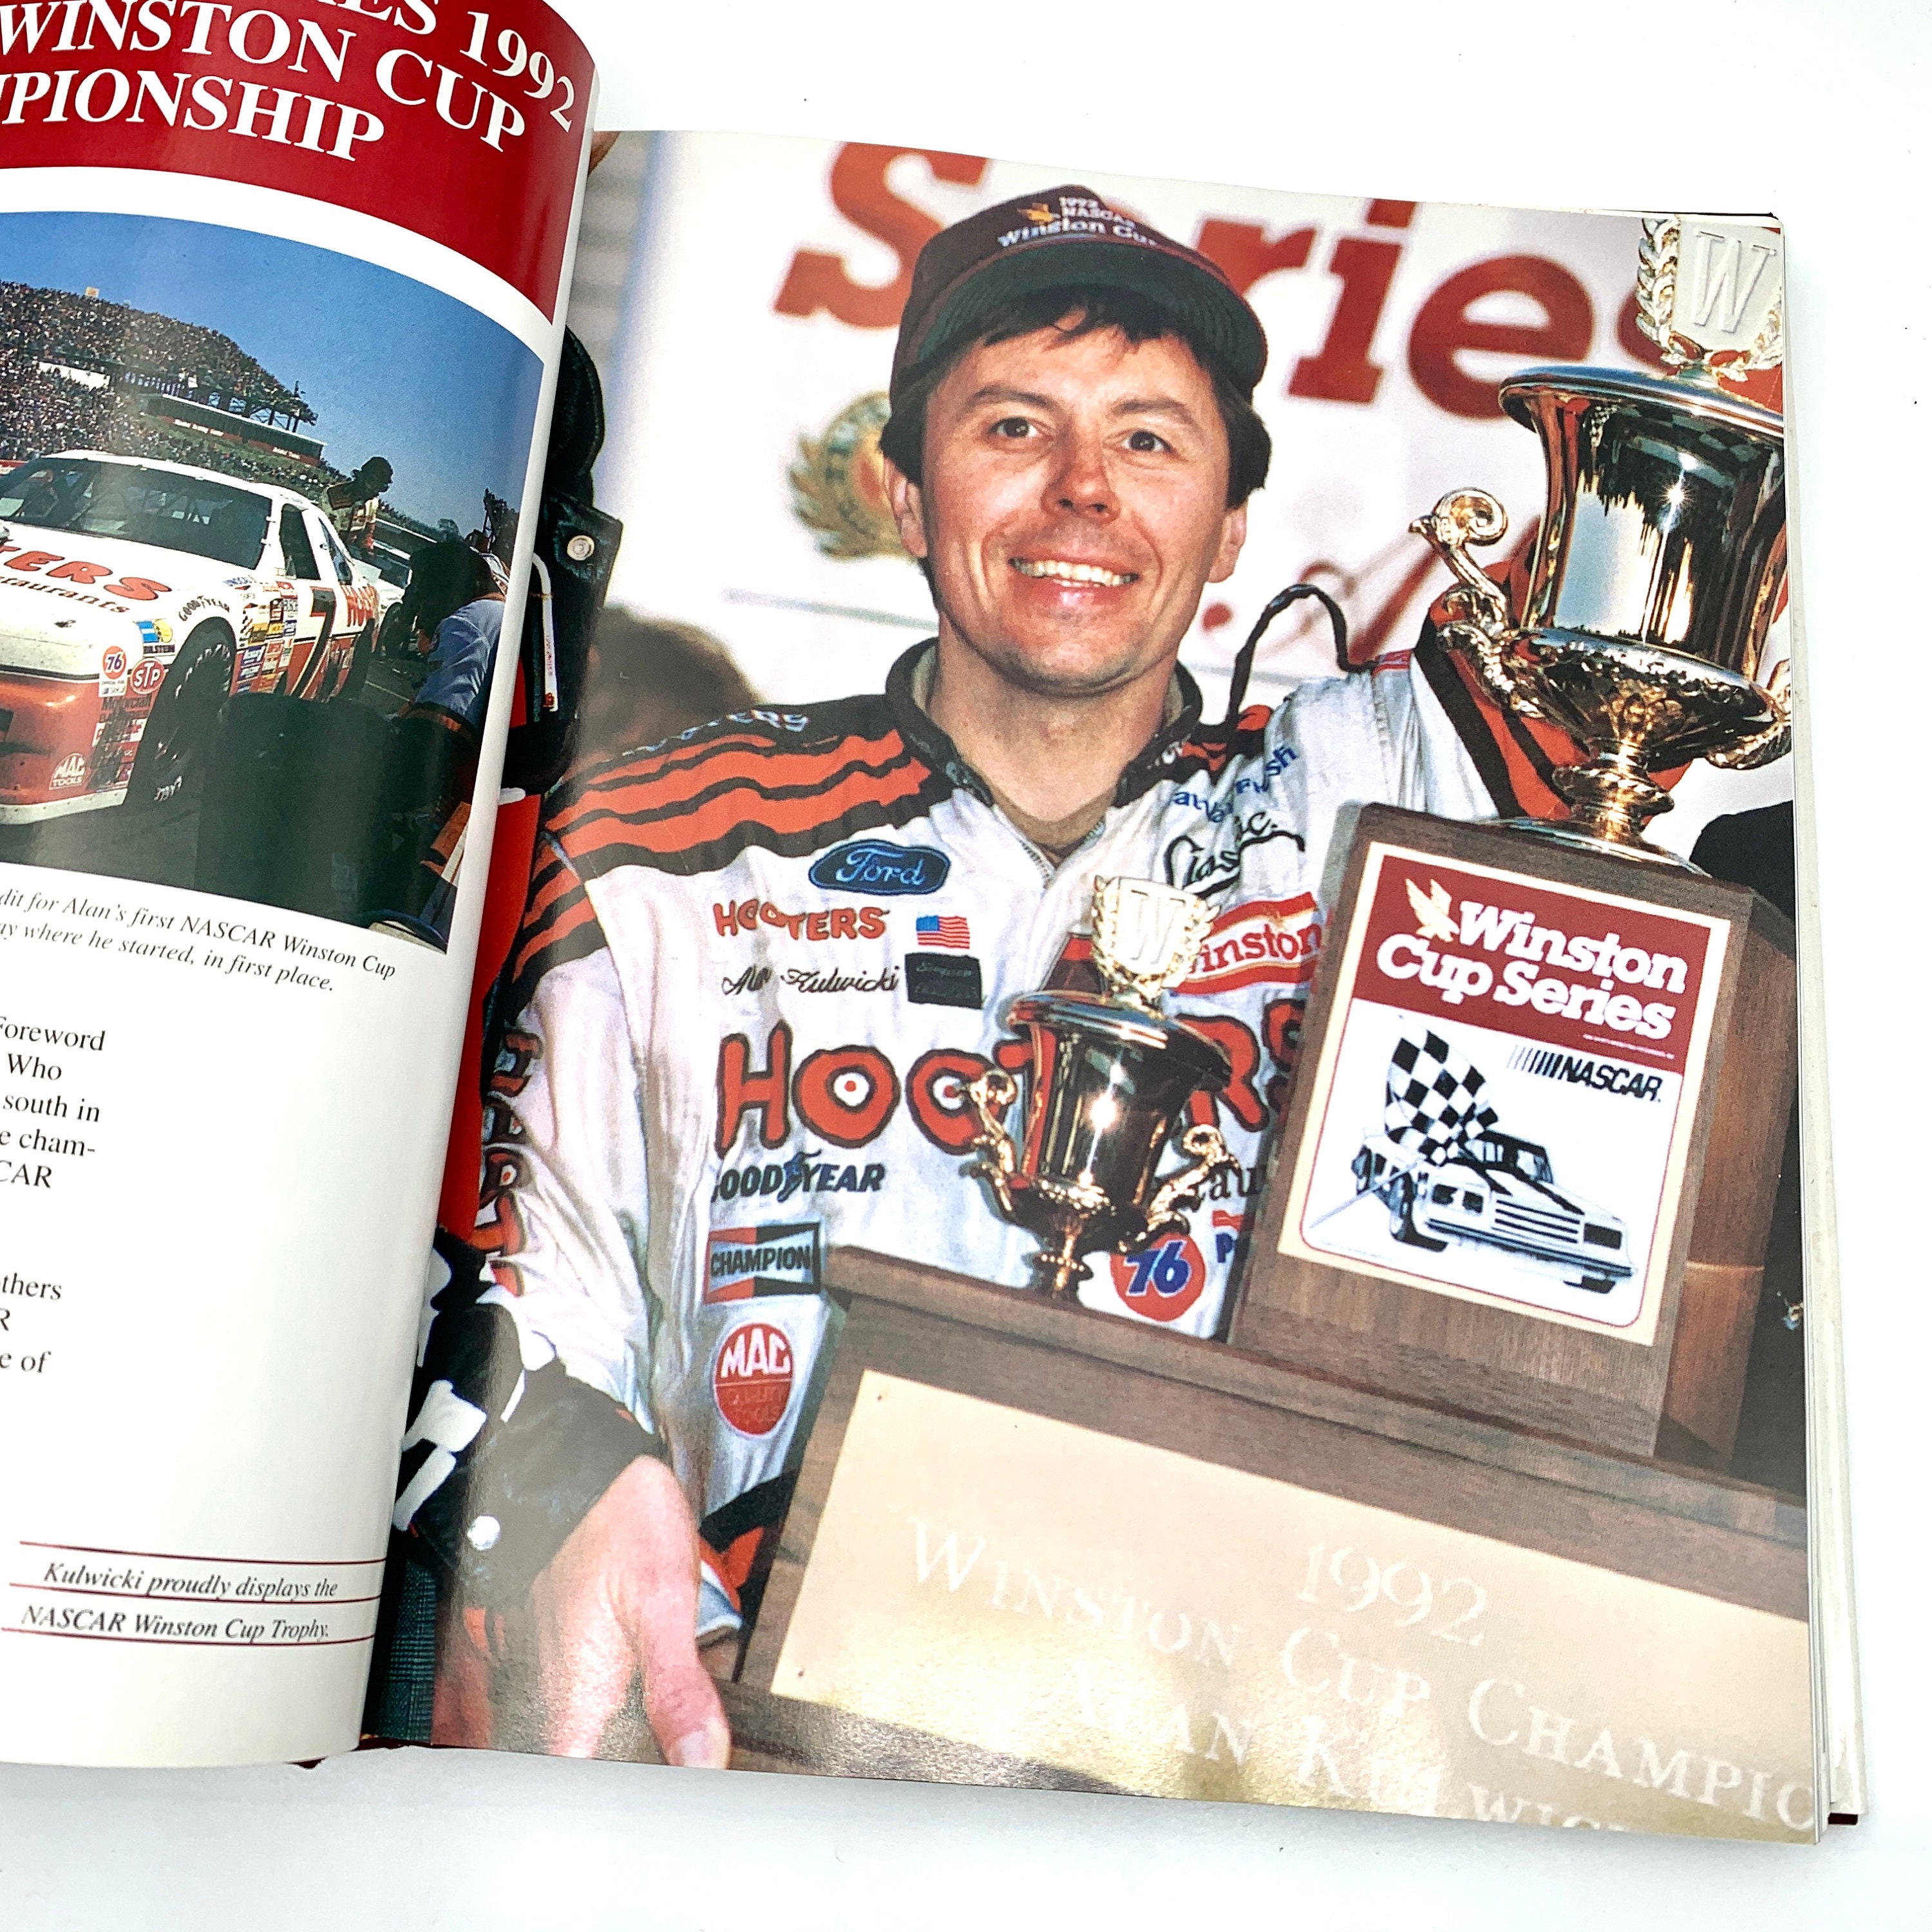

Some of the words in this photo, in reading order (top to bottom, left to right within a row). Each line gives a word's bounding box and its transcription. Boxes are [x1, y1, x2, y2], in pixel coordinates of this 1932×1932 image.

[0, 0, 357, 82] WINSTON
[375, 49, 525, 152] CUP
[459, 11, 574, 133] 1992
[0, 68, 384, 162] PIONSHIP
[998, 217, 1105, 247] Winston
[1691, 227, 1776, 334] W
[0, 544, 173, 600] ERS
[106, 652, 124, 674] 76
[134, 663, 161, 688] STP
[836, 848, 924, 886] Ford
[24, 893, 59, 913] for
[62, 898, 127, 921] Alan's
[127, 907, 175, 929] first
[180, 915, 276, 949] NASCAR
[284, 934, 356, 967] Winston
[363, 955, 395, 980] Cup
[713, 899, 890, 941] HOOTERS
[24, 923, 82, 944] where
[88, 930, 113, 949] he
[118, 940, 194, 965] started,
[204, 950, 223, 968] in
[225, 954, 272, 978] first
[274, 966, 333, 991] place.
[1190, 923, 1322, 974] inston
[1459, 900, 1689, 994] Winston
[780, 965, 900, 992] Kulwicki
[1377, 934, 1493, 1005] Cup
[1493, 960, 1676, 1040] Series
[8, 1053, 62, 1081] Who
[3, 1095, 67, 1118] south
[77, 1098, 100, 1122] in
[19, 1128, 95, 1157] cham-
[711, 1161, 885, 1202] OODYEAR
[711, 1246, 811, 1276] CHAMPION
[1127, 1243, 1190, 1297] 76
[0, 1273, 61, 1300] thers
[21, 1351, 52, 1373] of
[721, 1328, 791, 1378] MAC
[44, 1562, 144, 1589] Kulwicki
[144, 1574, 231, 1600] proudly
[236, 1576, 310, 1602] displays
[314, 1578, 338, 1597] the
[1296, 1546, 1488, 1647] 1992
[21, 1605, 126, 1633] NASCAR
[135, 1613, 218, 1638] Winston
[225, 1618, 265, 1643] Cup
[272, 1618, 329, 1643] Trophy.
[909, 1515, 1243, 1667] WINSTON
[1282, 1627, 1431, 1718] CUP
